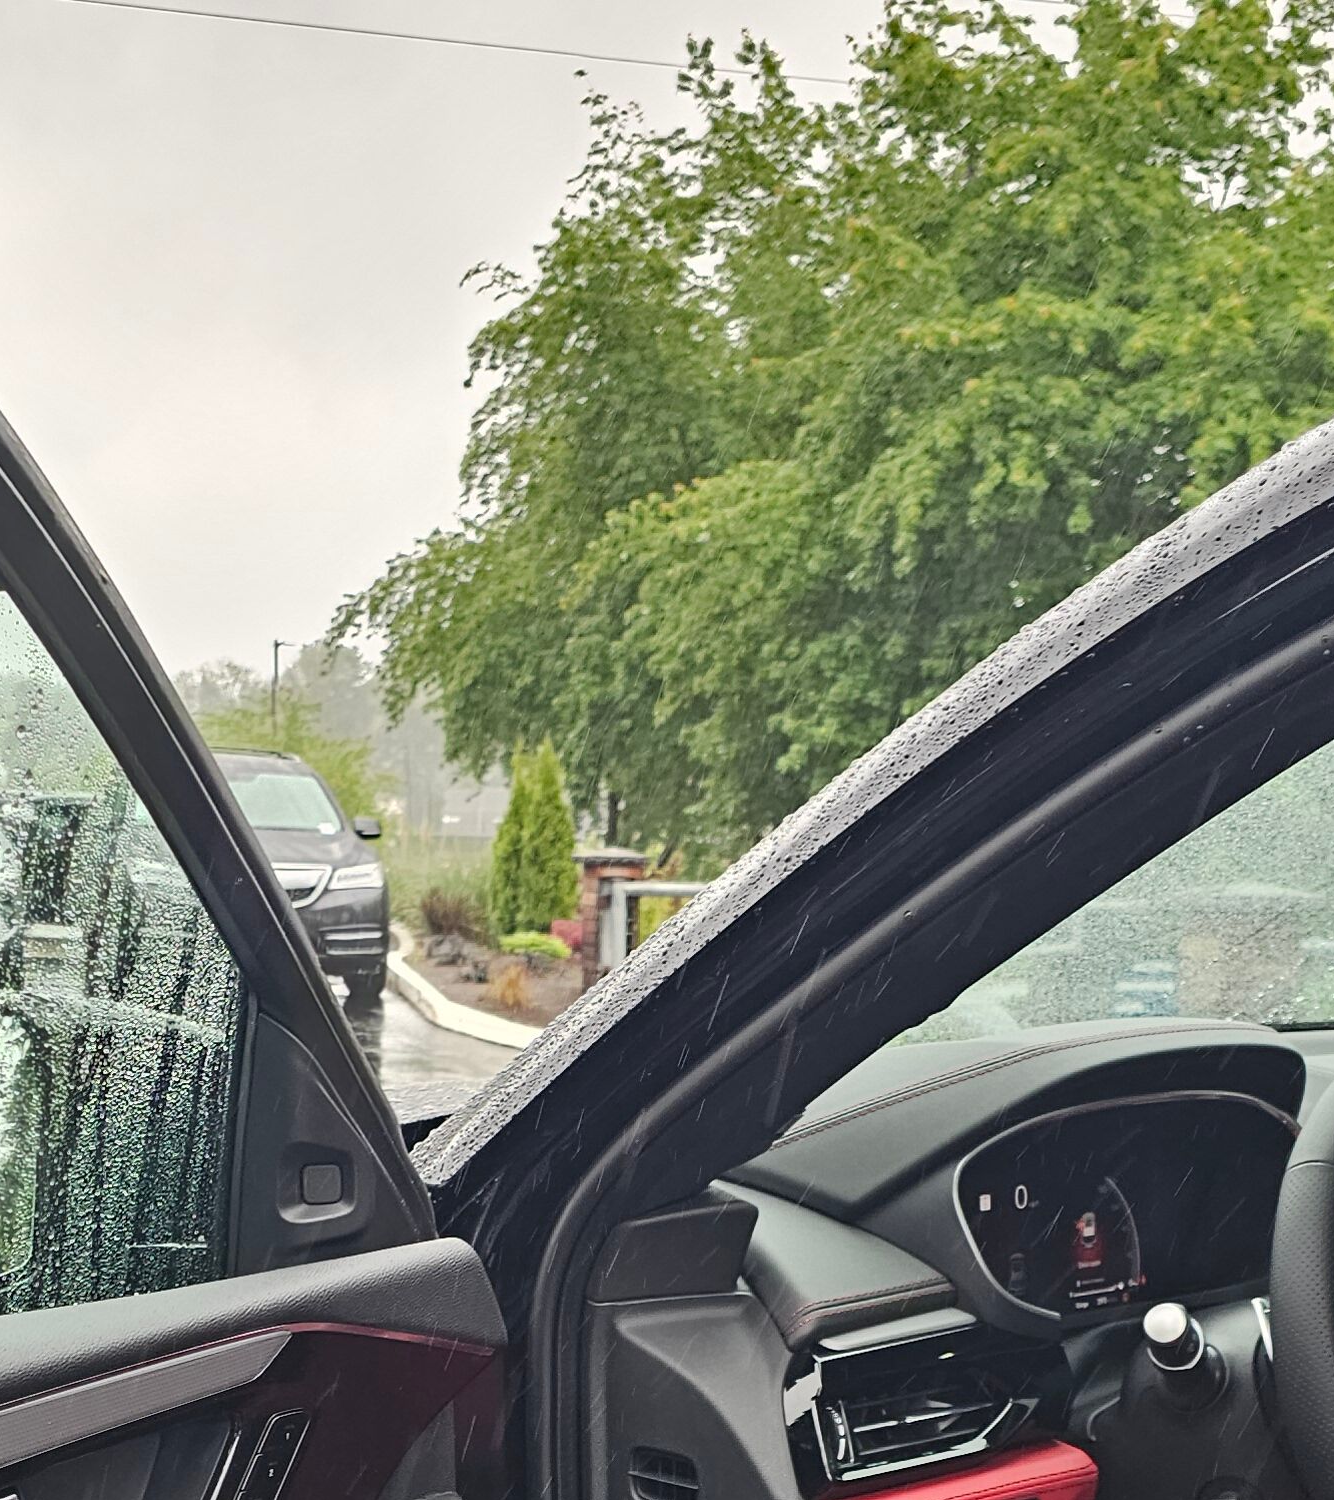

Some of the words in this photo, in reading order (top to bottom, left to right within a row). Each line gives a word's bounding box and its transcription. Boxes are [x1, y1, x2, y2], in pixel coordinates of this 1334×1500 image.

[1015, 1185, 1027, 1209] 0
[285, 1432, 290, 1441] 1
[268, 1468, 275, 1478] 2
